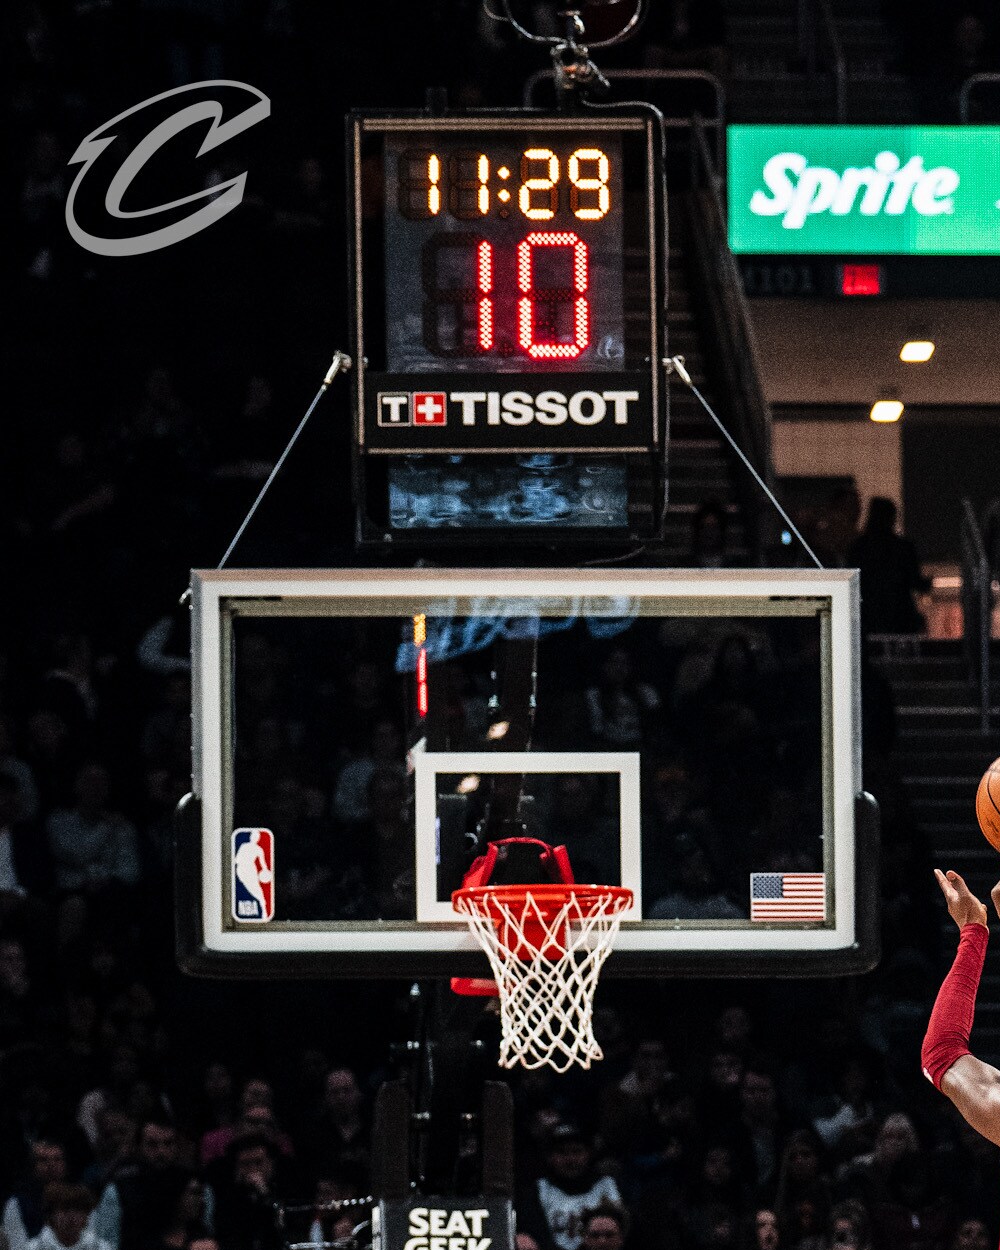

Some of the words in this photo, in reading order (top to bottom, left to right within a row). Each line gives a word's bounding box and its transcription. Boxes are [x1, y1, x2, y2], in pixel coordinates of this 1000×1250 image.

[427, 148, 610, 220] 11:29
[749, 150, 960, 229] Sprite
[477, 232, 589, 358] 10
[450, 391, 639, 426] TISSOT
[408, 1207, 489, 1237] SEAT
